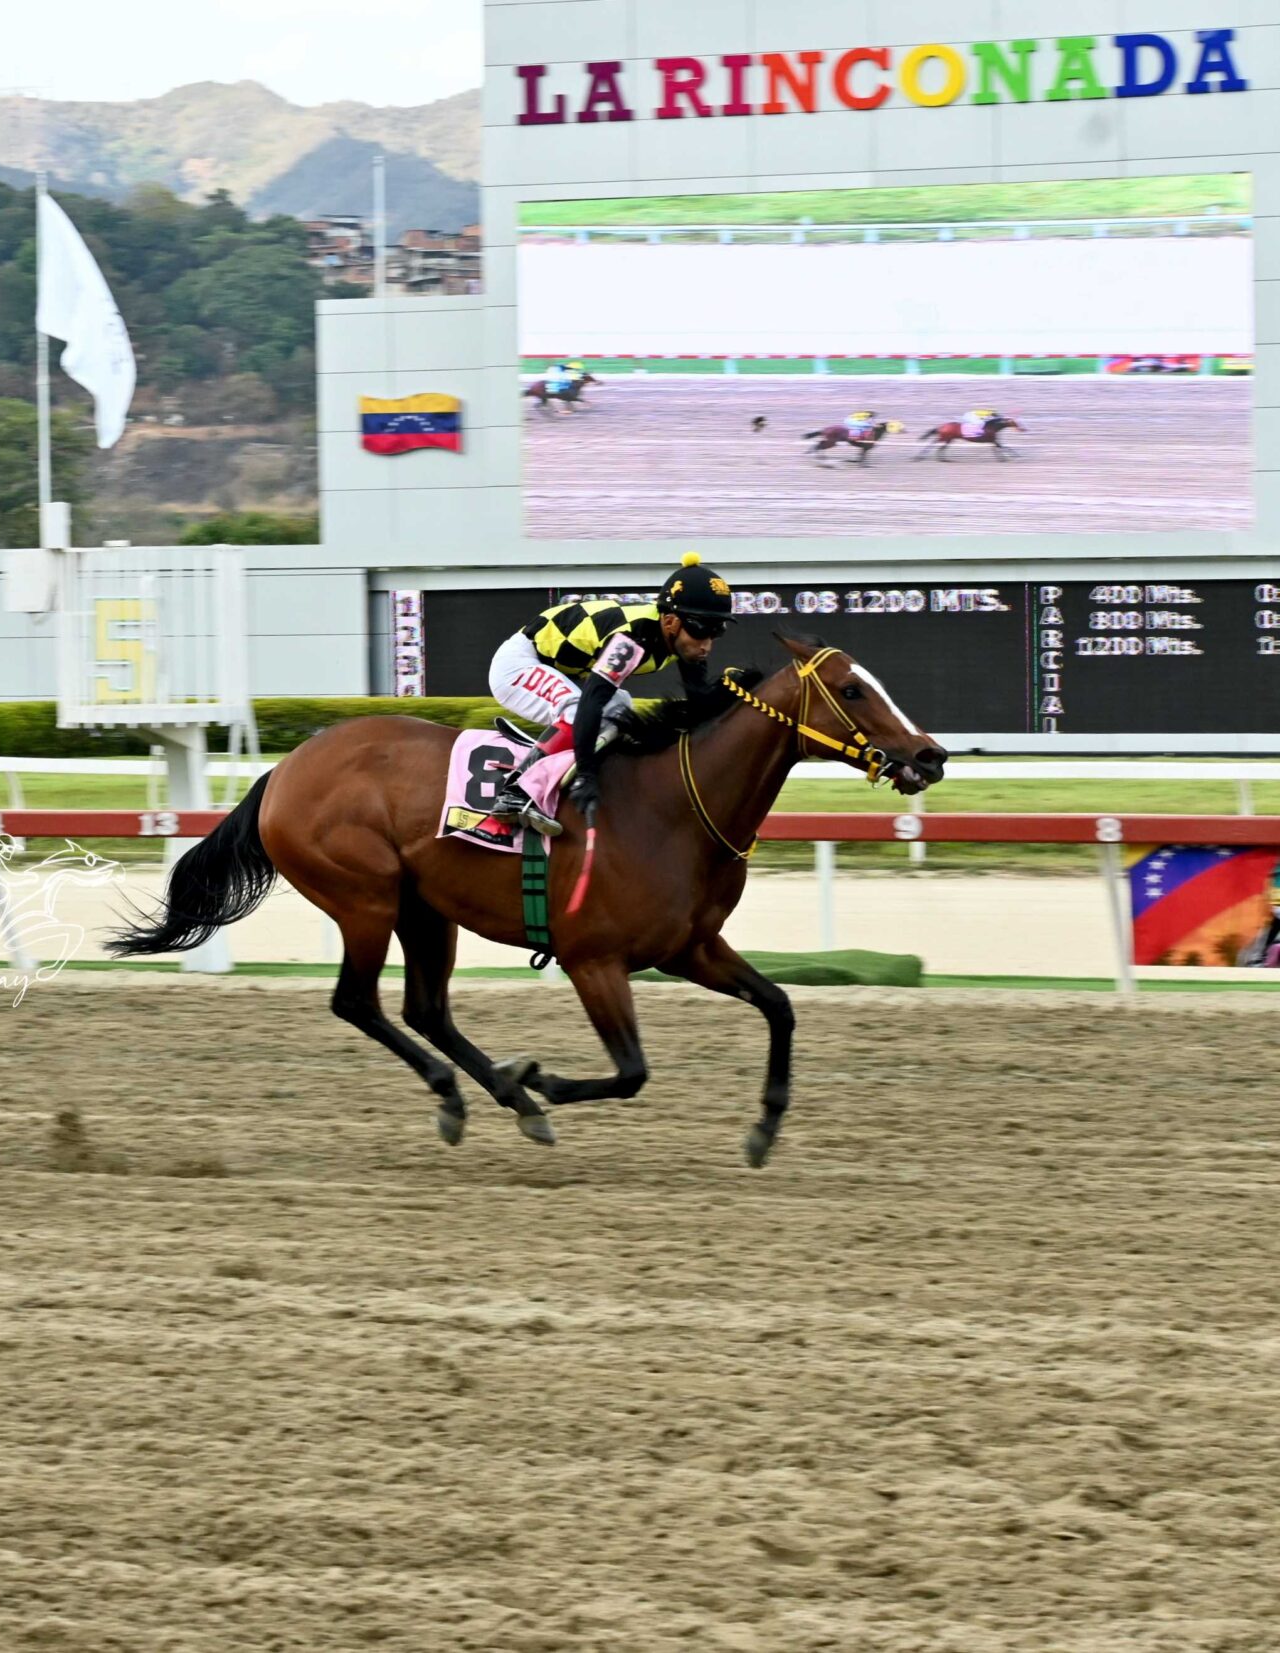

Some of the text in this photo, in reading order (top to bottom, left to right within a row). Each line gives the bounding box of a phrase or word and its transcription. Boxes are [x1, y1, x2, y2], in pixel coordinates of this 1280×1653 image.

[515, 28, 1248, 126] LA RINCONADA
[731, 591, 789, 614] RO.
[844, 589, 925, 613] 1200
[94, 597, 157, 704] 5
[607, 641, 635, 672] 8
[464, 744, 516, 811] 8
[138, 812, 180, 836] 13
